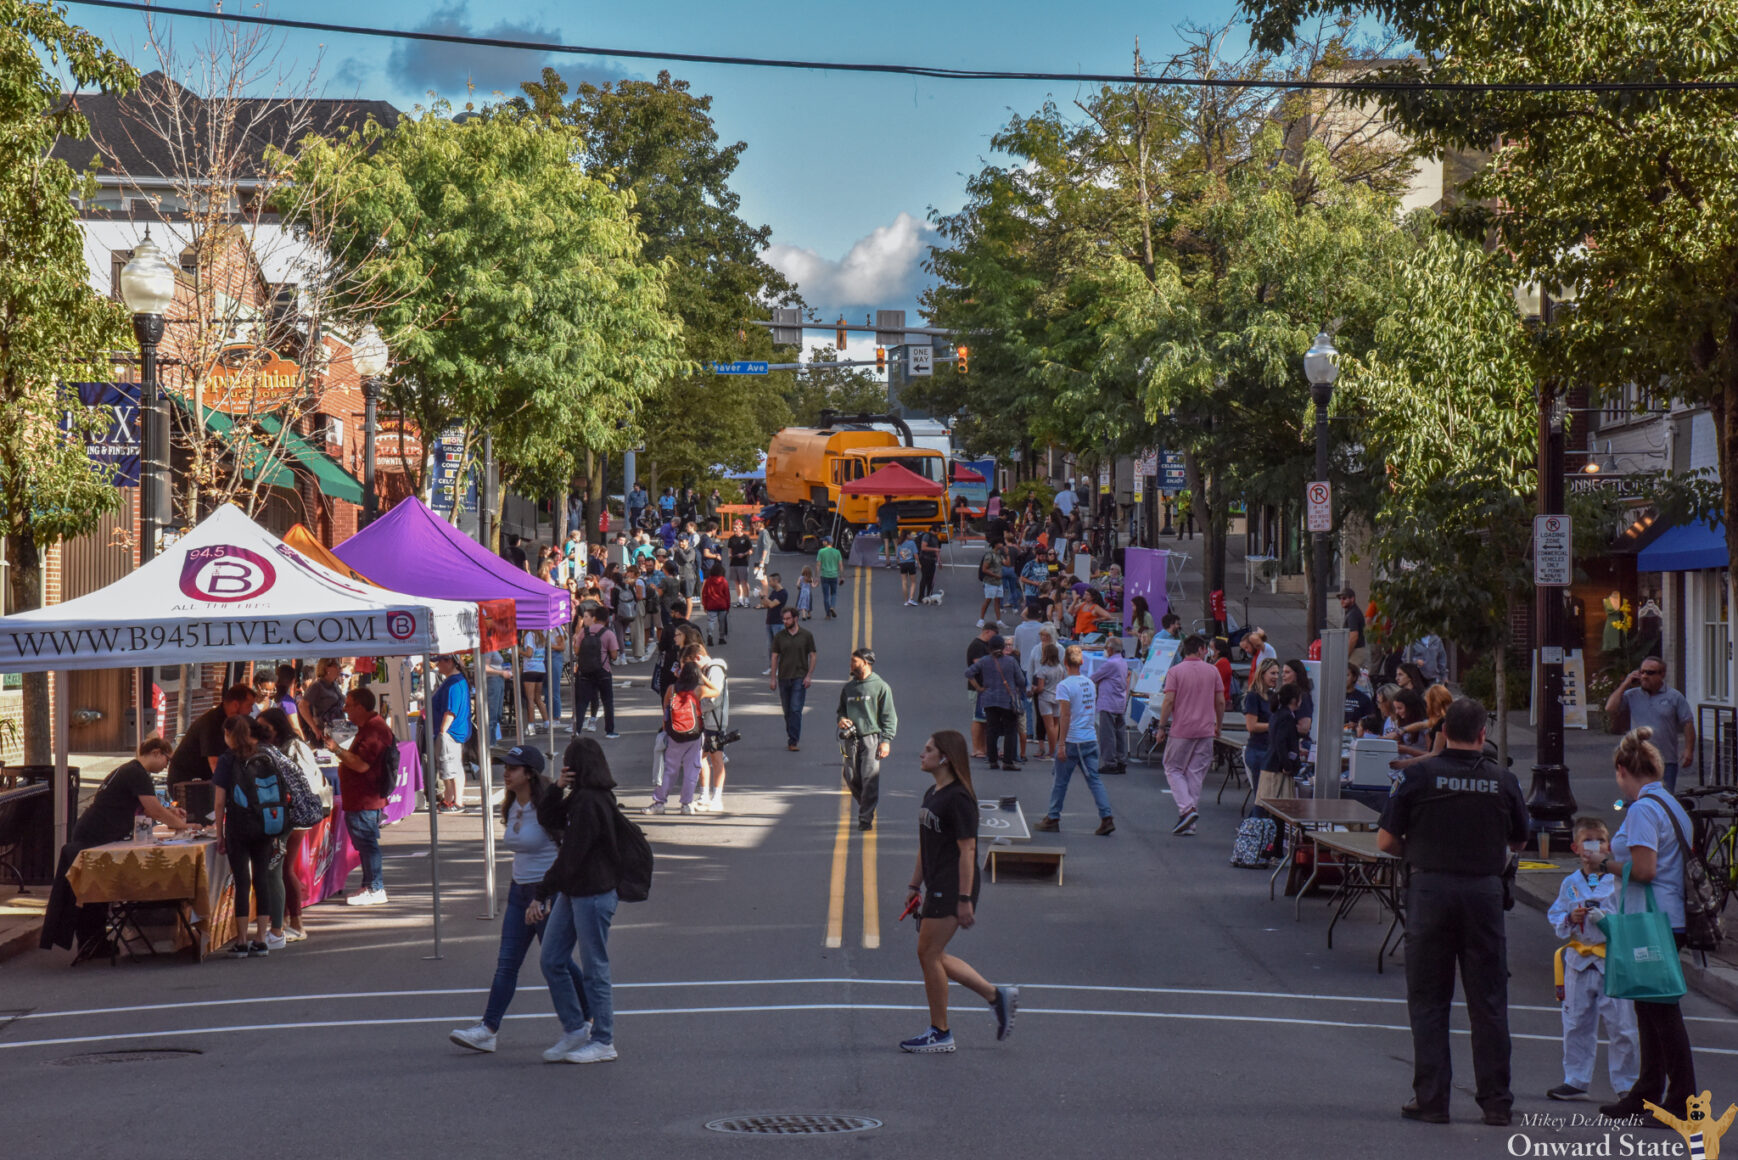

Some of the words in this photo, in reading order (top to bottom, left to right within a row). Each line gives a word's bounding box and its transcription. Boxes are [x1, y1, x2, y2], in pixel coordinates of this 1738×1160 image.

[913, 348, 929, 356] ONE
[711, 363, 741, 372] eaver
[190, 546, 225, 560] 94.5
[208, 561, 252, 593] B
[9, 616, 378, 657] WWW.B945LIVE.COM
[1436, 776, 1499, 794] POLICE
